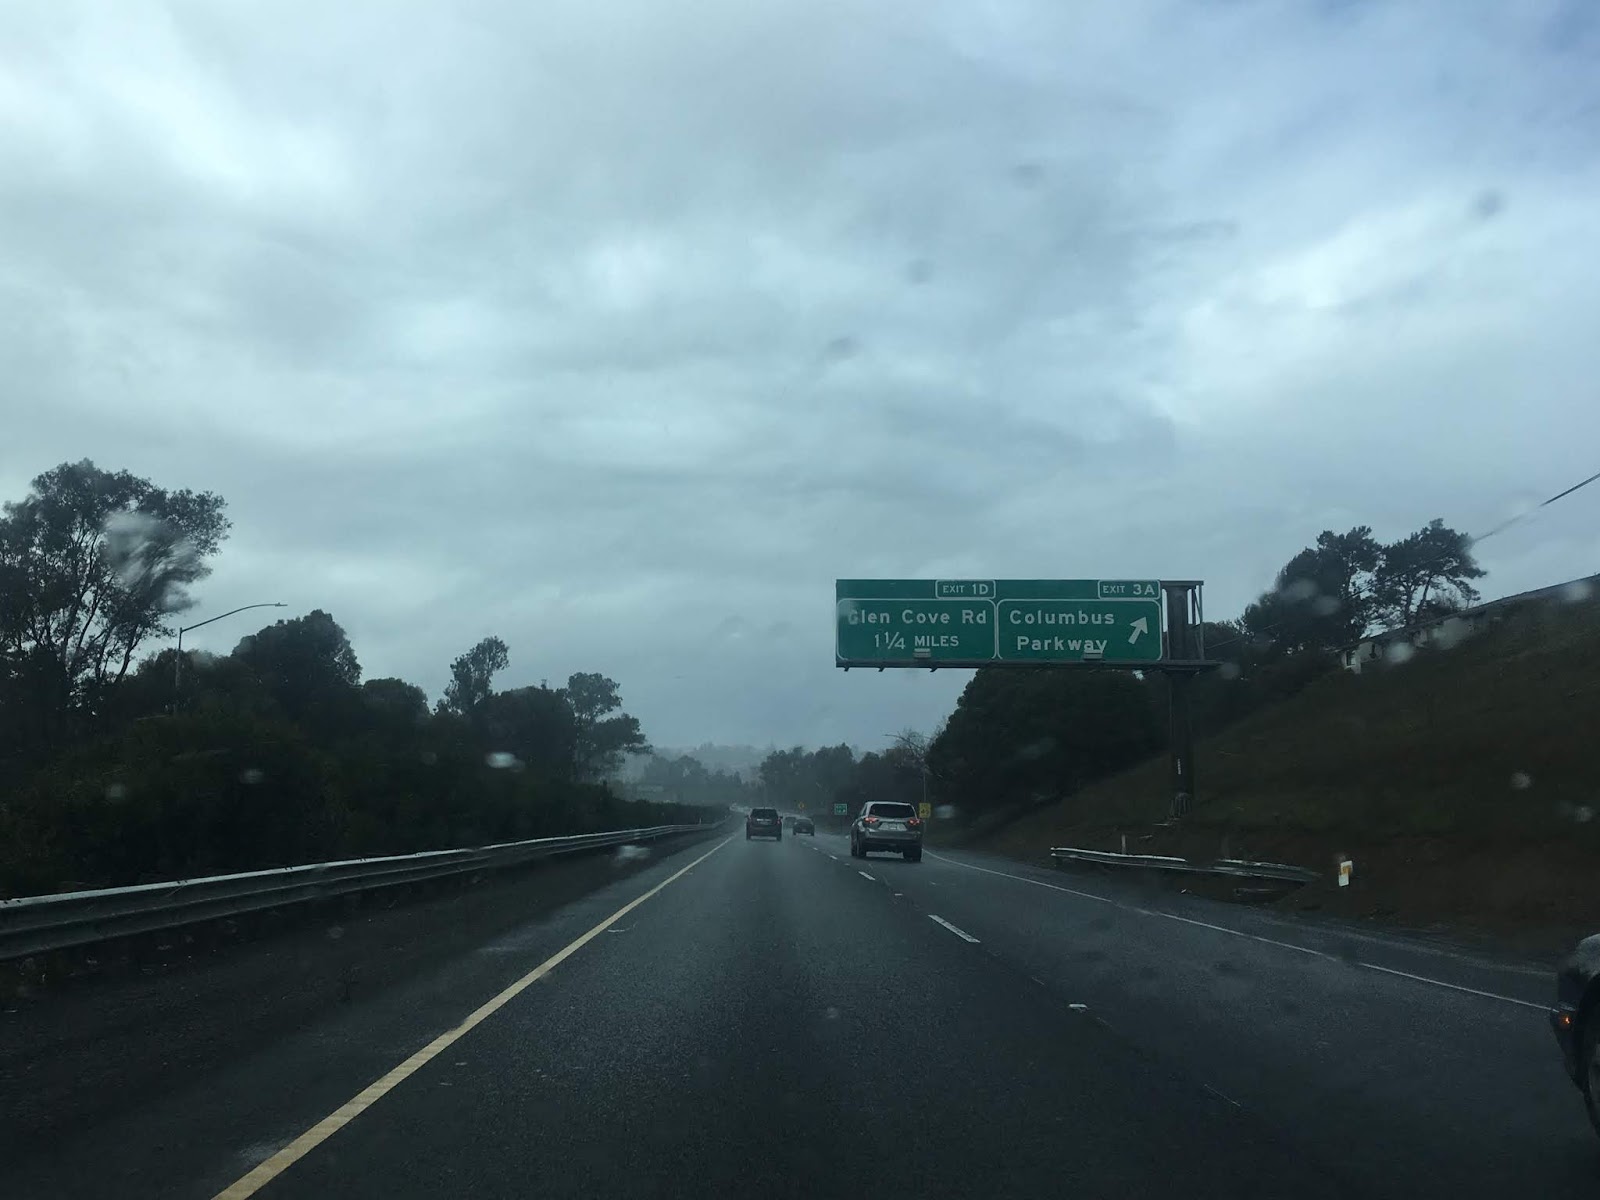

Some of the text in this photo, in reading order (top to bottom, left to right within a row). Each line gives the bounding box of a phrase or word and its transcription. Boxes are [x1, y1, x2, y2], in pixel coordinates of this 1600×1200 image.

[942, 584, 989, 595] EXIT 1D
[1102, 584, 1155, 595] EXIT 3A
[848, 609, 987, 625] Glen Cove Rd
[1009, 610, 1115, 625] Columbus
[914, 635, 959, 647] MILES
[1016, 635, 1108, 654] Parkway
